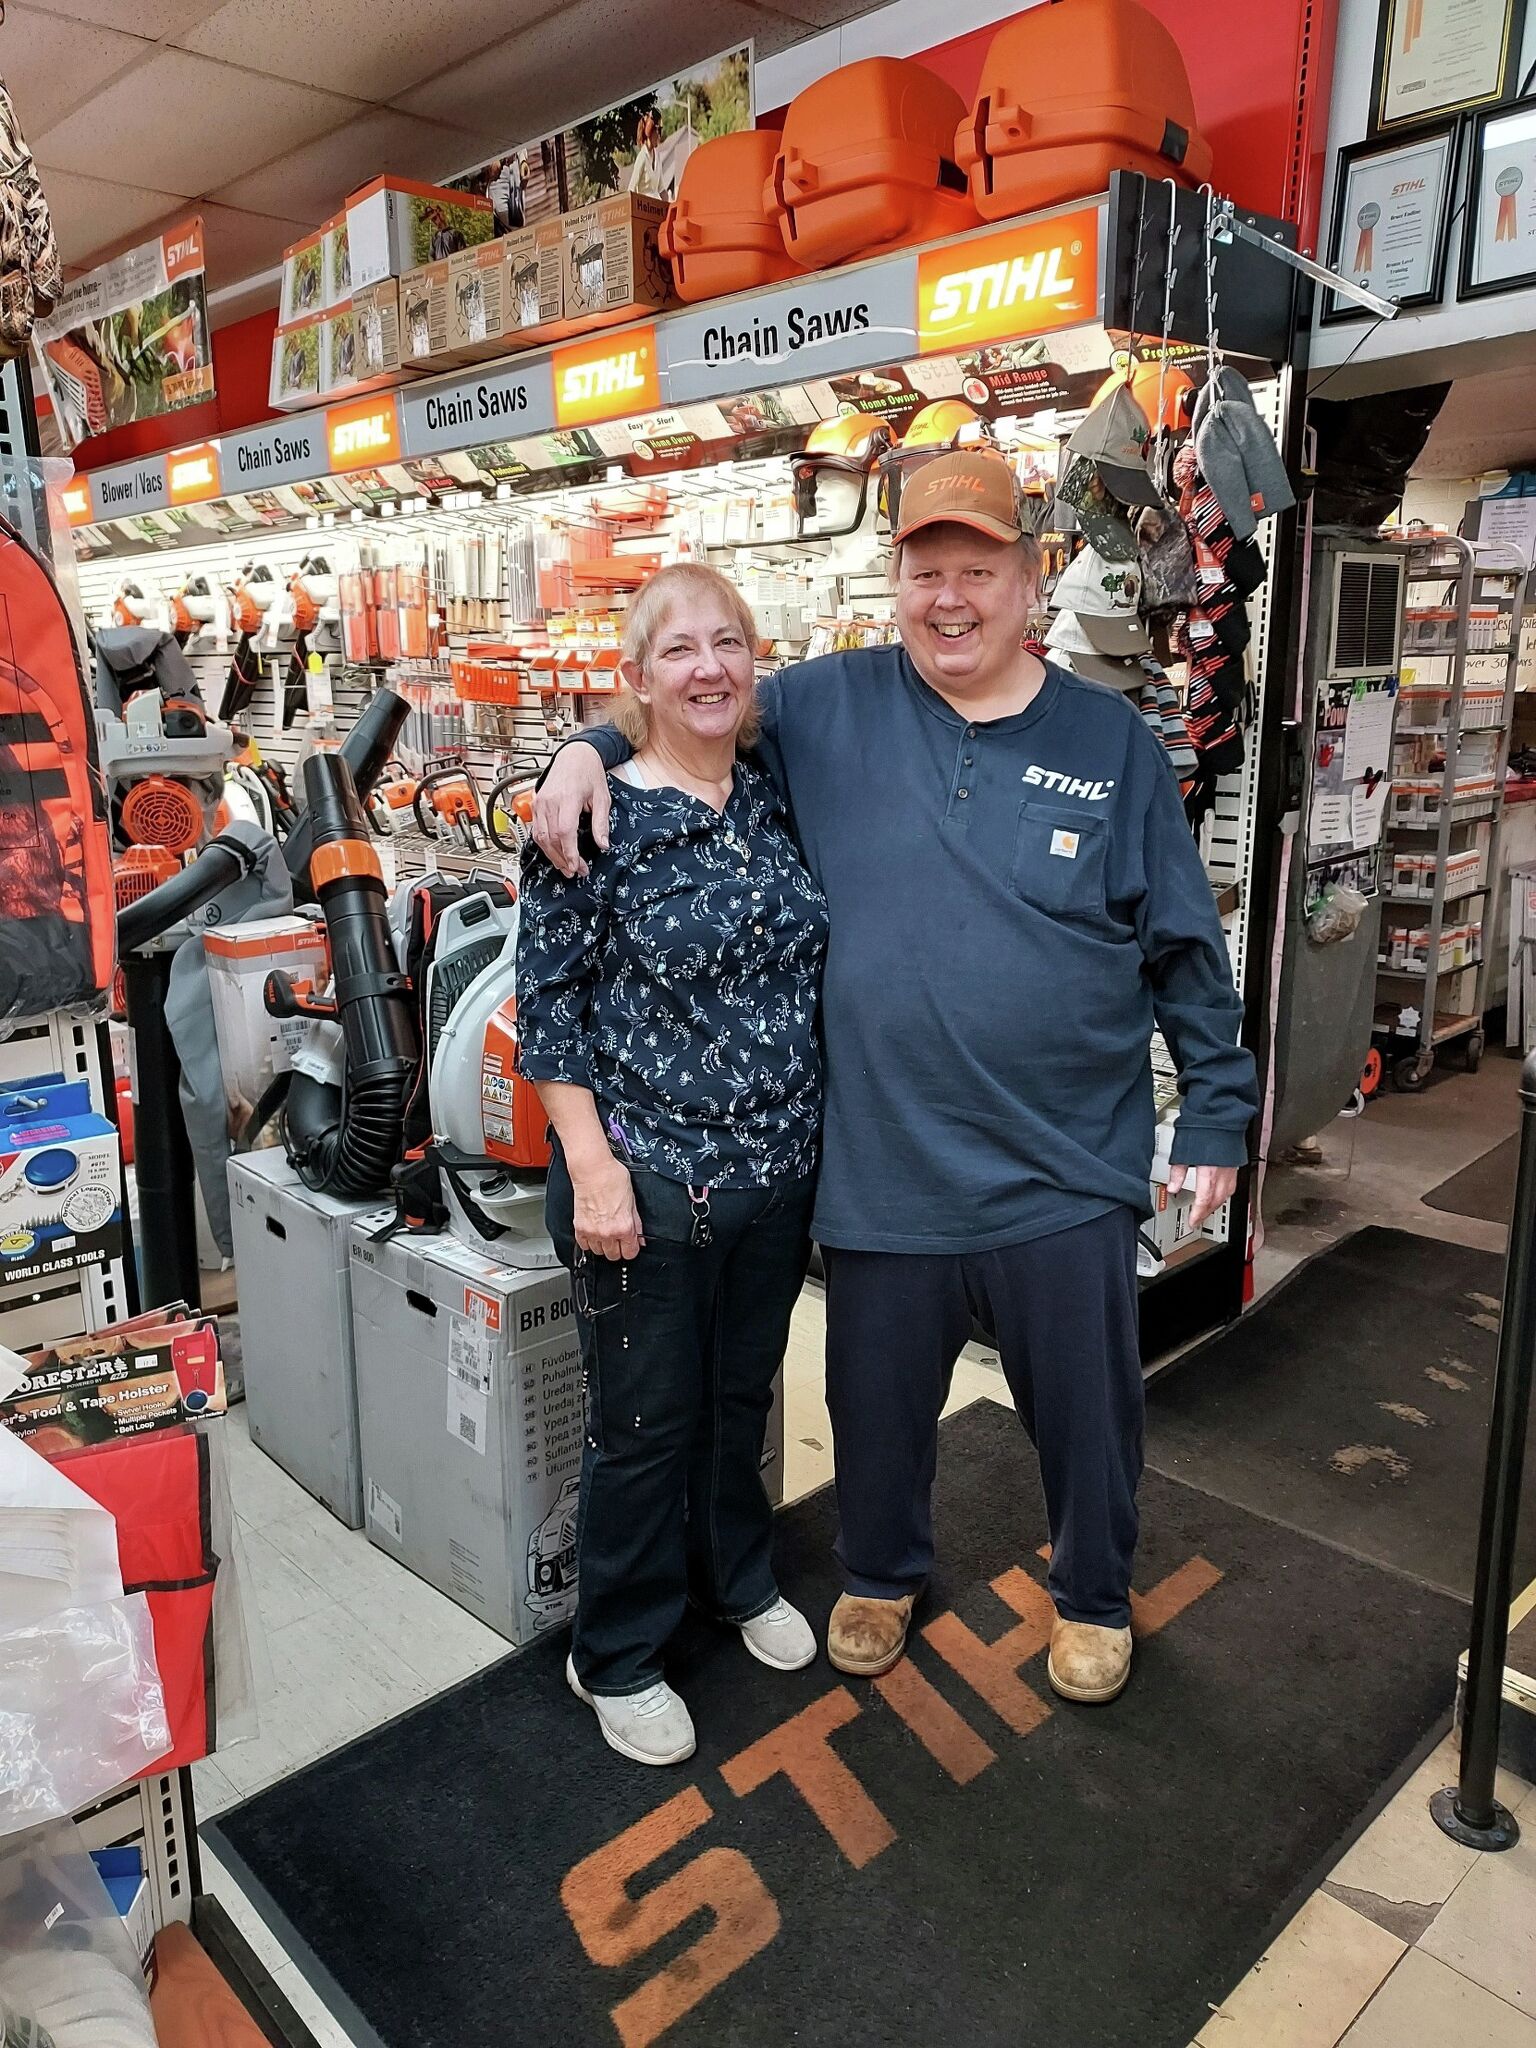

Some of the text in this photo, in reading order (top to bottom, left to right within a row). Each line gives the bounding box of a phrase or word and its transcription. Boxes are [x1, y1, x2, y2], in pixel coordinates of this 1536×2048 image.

[1391, 178, 1426, 196] STIHL
[600, 205, 628, 223] STIHL
[637, 200, 664, 217] Helmet
[564, 219, 580, 229] Helmet
[167, 233, 200, 268] STIHL
[929, 247, 1076, 324] STIHL
[703, 303, 871, 369] Chain Saws
[562, 351, 645, 404] STIHL
[988, 369, 1048, 388] Mid Range
[426, 385, 528, 430] Chain Saws
[860, 391, 920, 412] Home Owner
[627, 422, 644, 431] Easy
[656, 415, 675, 426] Start
[332, 412, 392, 456] STIHL
[649, 433, 695, 449] Home Owner
[237, 437, 311, 473] Chain Saws
[101, 479, 135, 504] Blower
[138, 472, 163, 494] Vacs
[924, 474, 986, 497] STIHL
[1039, 532, 1066, 544] STIHL
[1465, 658, 1487, 668] over
[1491, 657, 1508, 669] 30
[1022, 765, 1110, 801] STIHL
[297, 937, 323, 947] STIHL
[267, 978, 276, 1004] STIHL
[62, 1190, 80, 1218] Original
[352, 1244, 375, 1264] BR 800
[5, 1249, 106, 1282] WORLD CLASS TOOLS
[520, 1304, 546, 1333] BR
[17, 1361, 116, 1393] ORESTER
[66, 1377, 103, 1390] POWERED BY
[543, 1364, 583, 1385] Puhalnik
[30, 1404, 62, 1420] Tool
[65, 1401, 78, 1413] &
[80, 1394, 116, 1409] Tape
[118, 1383, 170, 1401] Holster
[117, 1400, 167, 1418] Swivel Hooks
[118, 1407, 178, 1426] Multiple Pockets
[119, 1421, 155, 1434] Belt Loop
[545, 1601, 563, 1611] STIHL
